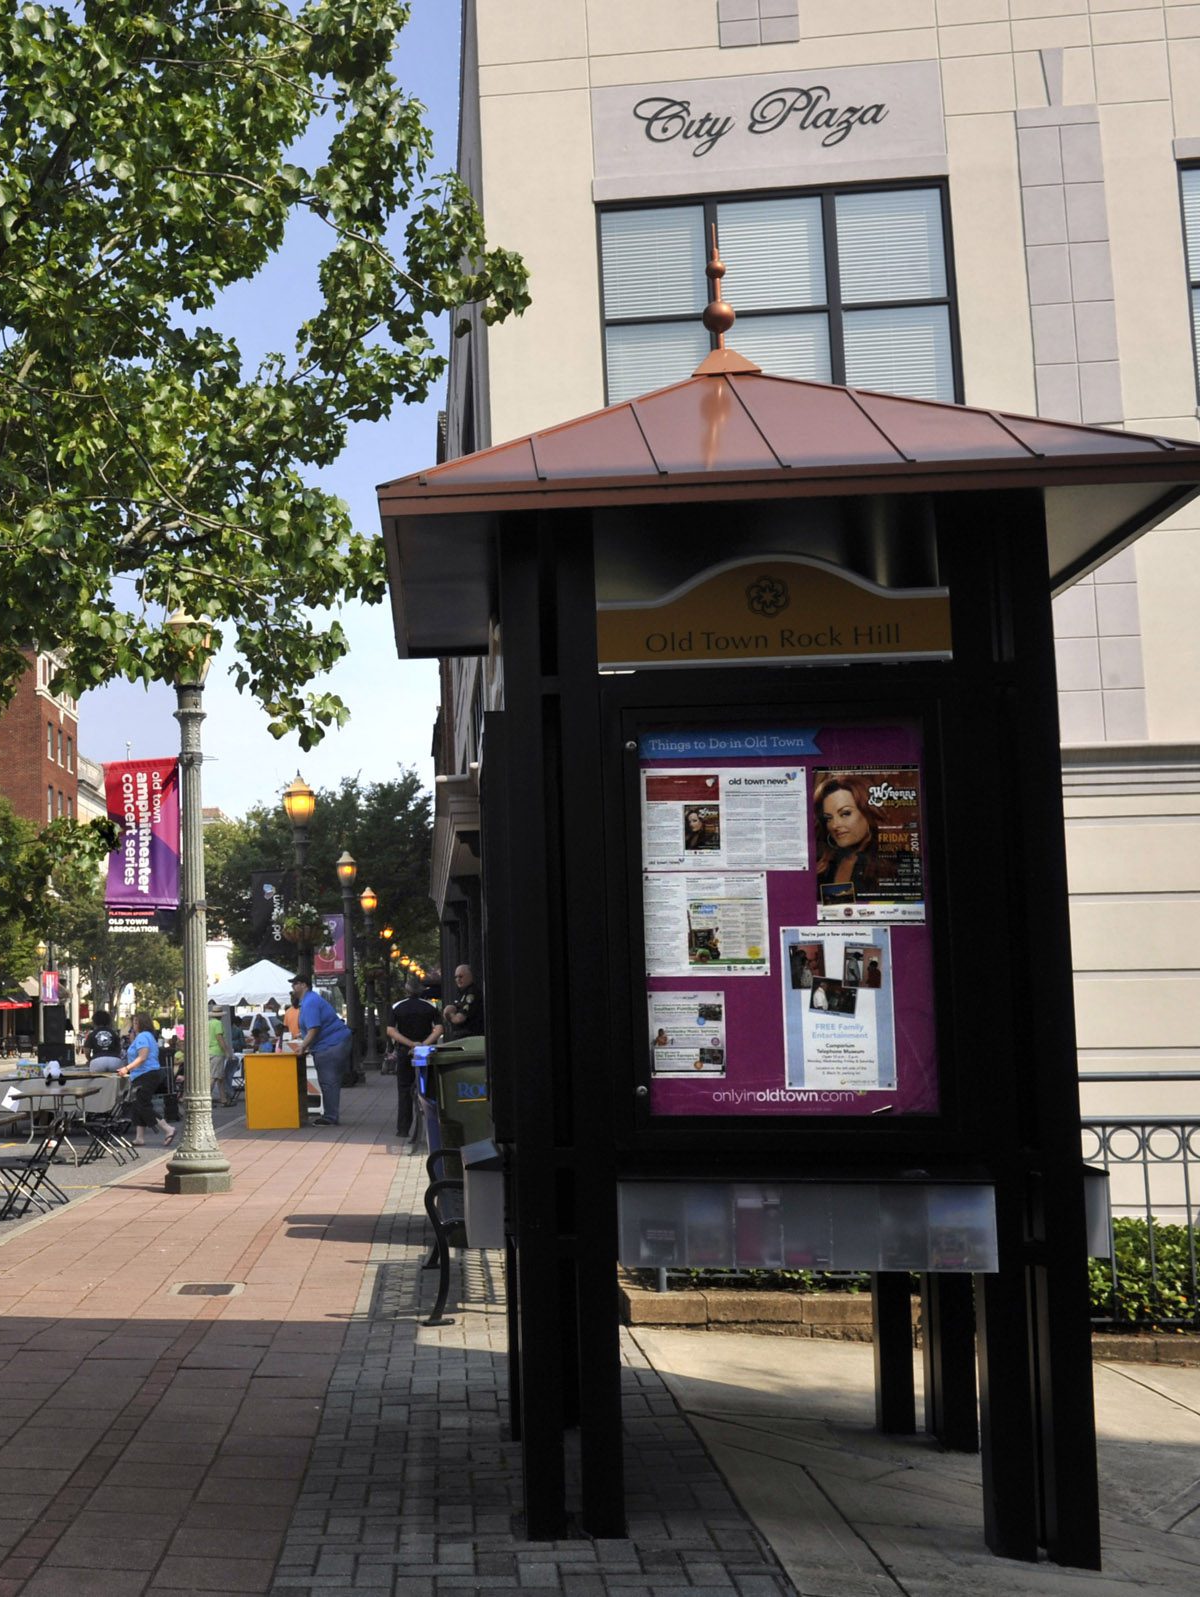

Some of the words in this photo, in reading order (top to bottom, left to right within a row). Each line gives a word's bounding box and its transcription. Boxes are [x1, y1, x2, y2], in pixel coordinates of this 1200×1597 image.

[633, 96, 736, 157] City
[748, 85, 890, 147] Plaza
[645, 629, 693, 653] Old
[700, 631, 769, 651] Town
[780, 626, 843, 648] Rock
[853, 623, 901, 645] Hill
[648, 738, 691, 752] Things
[694, 739, 706, 749] to
[709, 738, 727, 749] Do
[729, 737, 742, 748] in
[744, 736, 767, 748] Old
[770, 736, 804, 747] Town
[152, 771, 162, 790] old
[728, 777, 742, 785] old
[869, 782, 917, 800] Wynonna
[121, 773, 138, 836] concert
[152, 793, 161, 824] town
[136, 772, 152, 894] amphitheater
[878, 833, 909, 842] FRIDAY
[910, 832, 920, 852] 2014
[124, 838, 138, 886] series
[108, 925, 159, 933] ASSOCIATION
[272, 924, 282, 941] old
[815, 1023, 836, 1031] FREE
[838, 1023, 864, 1032] Family
[712, 1088, 855, 1104] onlyinoldtown.com
